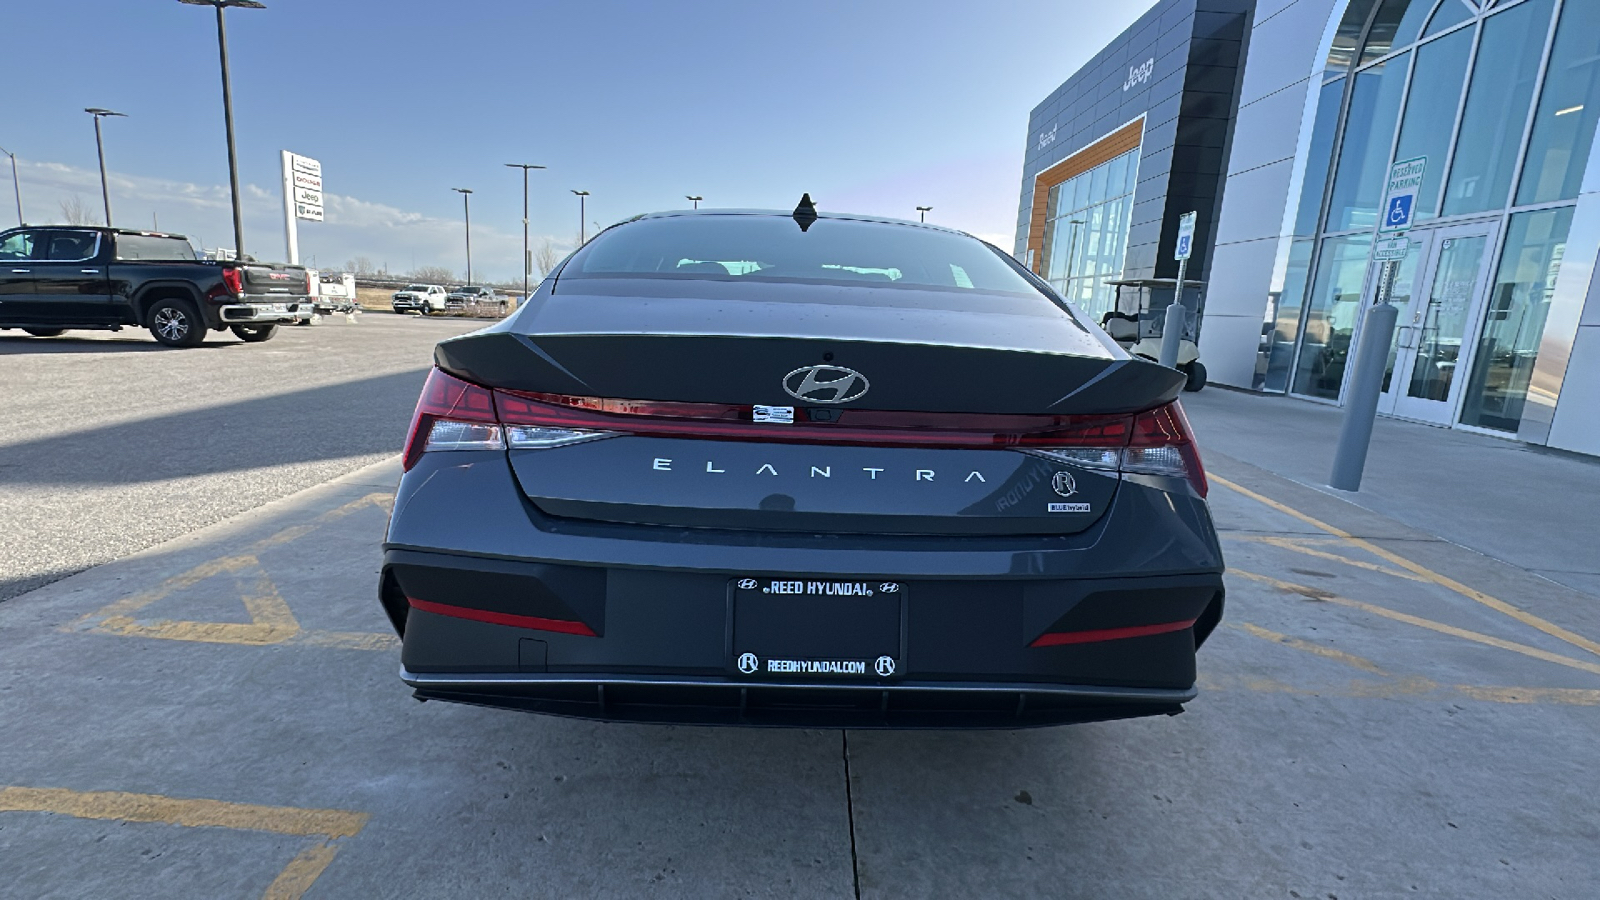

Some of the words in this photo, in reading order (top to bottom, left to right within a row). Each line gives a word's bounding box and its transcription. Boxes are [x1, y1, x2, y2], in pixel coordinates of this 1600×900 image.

[1123, 58, 1154, 91] Jeep
[1393, 163, 1423, 178] RESERVED
[1390, 176, 1421, 190] PARKING
[301, 191, 319, 203] Jeep
[652, 457, 986, 483] ELANTRA
[771, 580, 804, 594] REED
[807, 581, 867, 596] HYUNDAI
